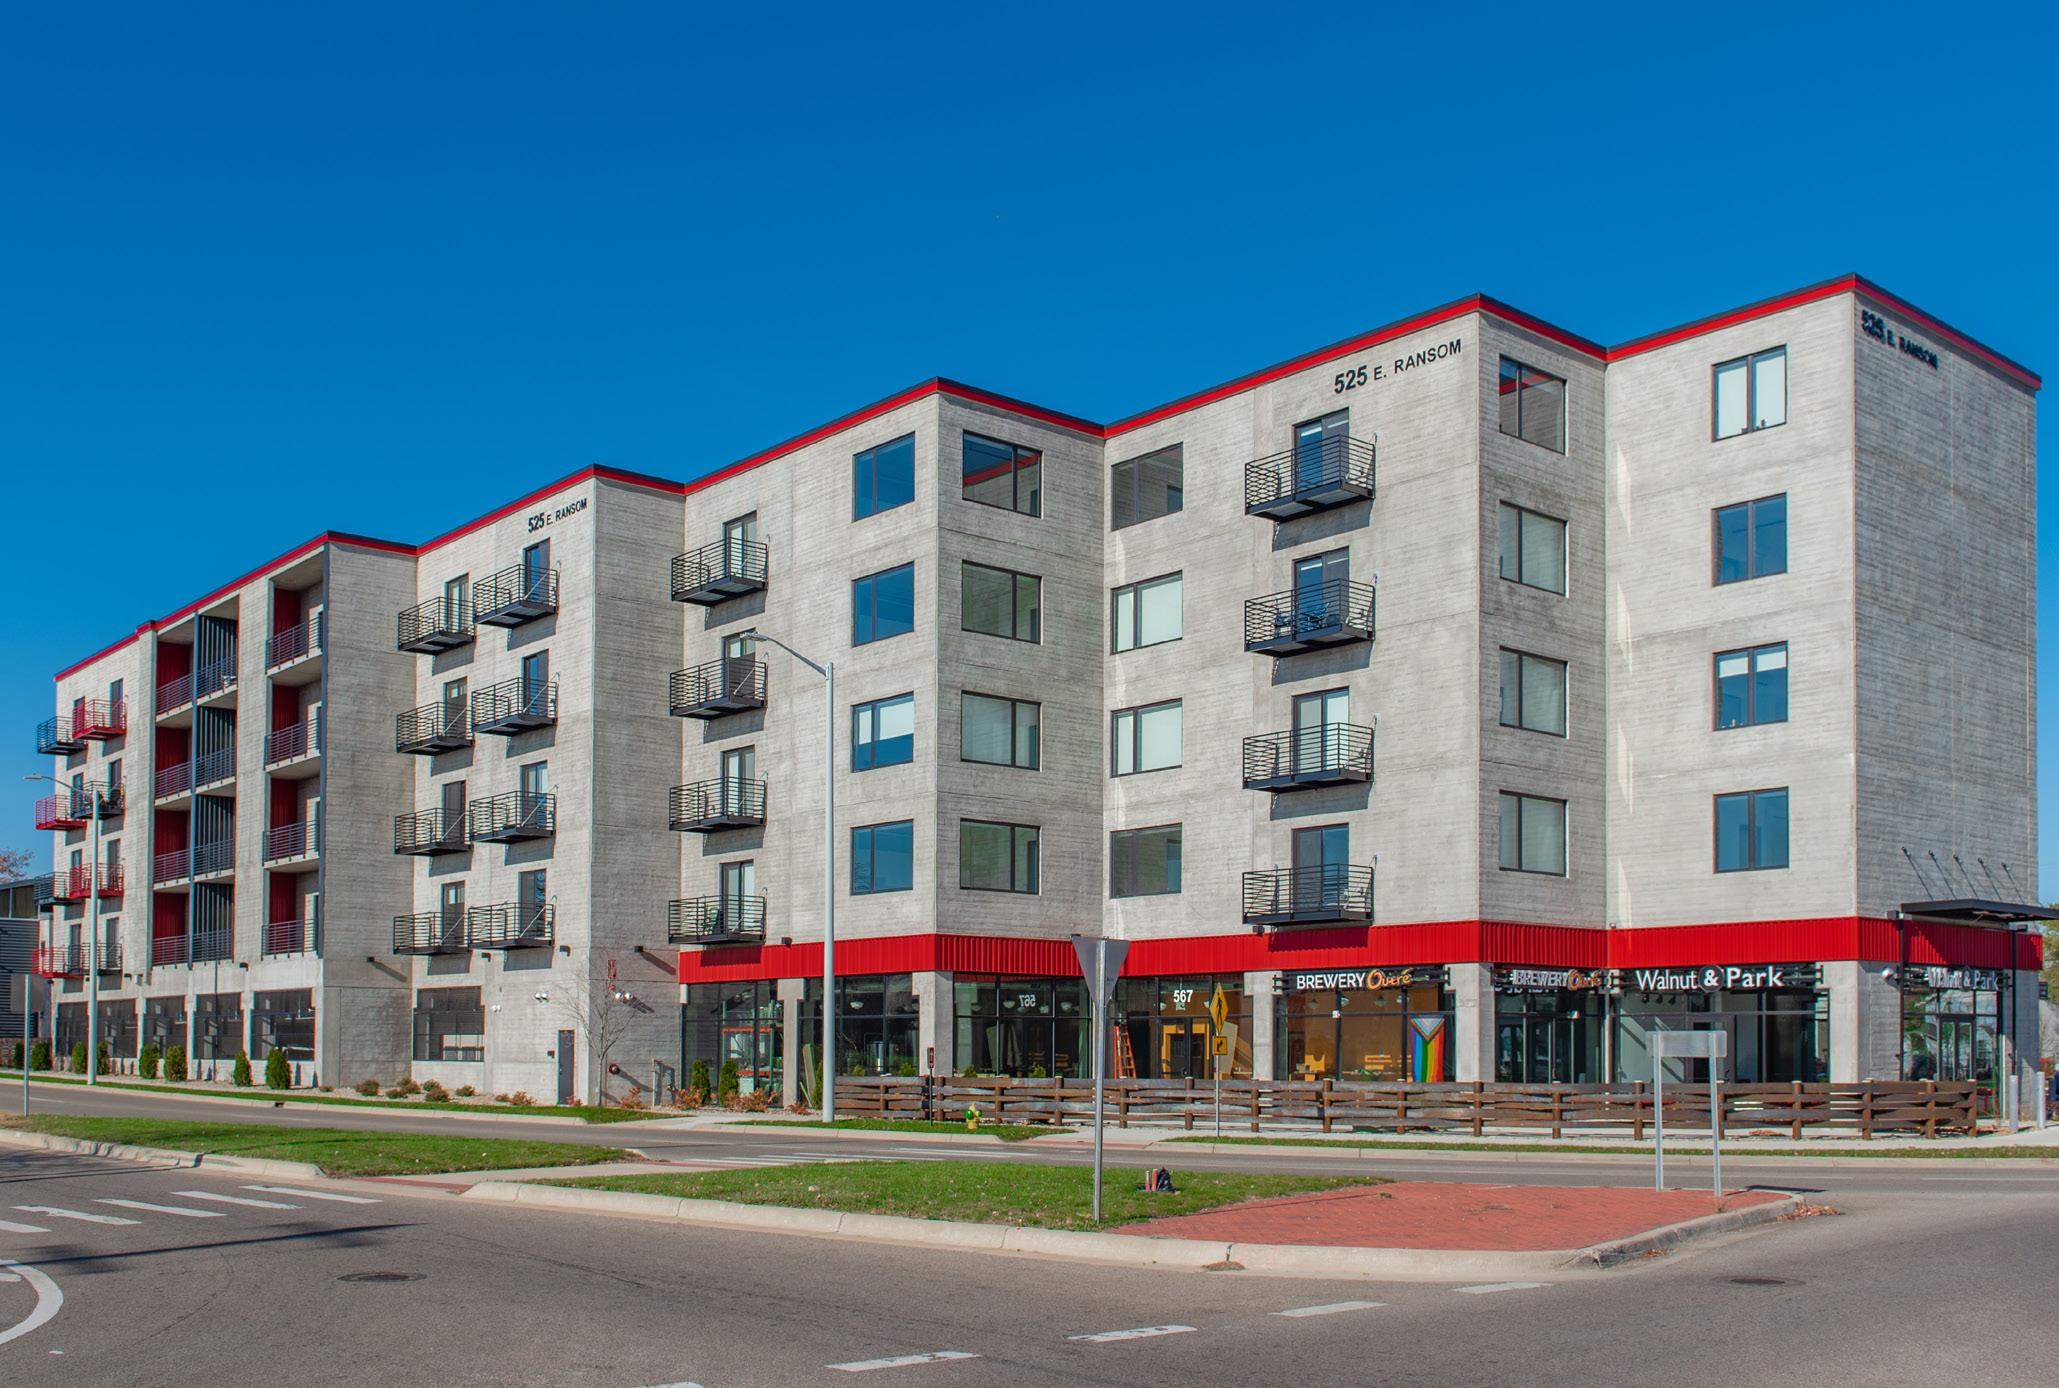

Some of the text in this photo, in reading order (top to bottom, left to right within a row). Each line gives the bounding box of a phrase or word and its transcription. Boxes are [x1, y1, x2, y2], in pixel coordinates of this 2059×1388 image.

[1861, 309, 1884, 340] 525
[1334, 339, 1462, 394] 525 E. RANSOM
[528, 512, 545, 533] 525
[555, 498, 588, 521] RANSOM
[1297, 973, 1366, 989] BREWERY
[1513, 969, 1569, 987] BREWERY
[1636, 966, 1784, 991] Walnut & Park
[1973, 970, 2000, 991] Park
[1173, 990, 1193, 1003] 567
